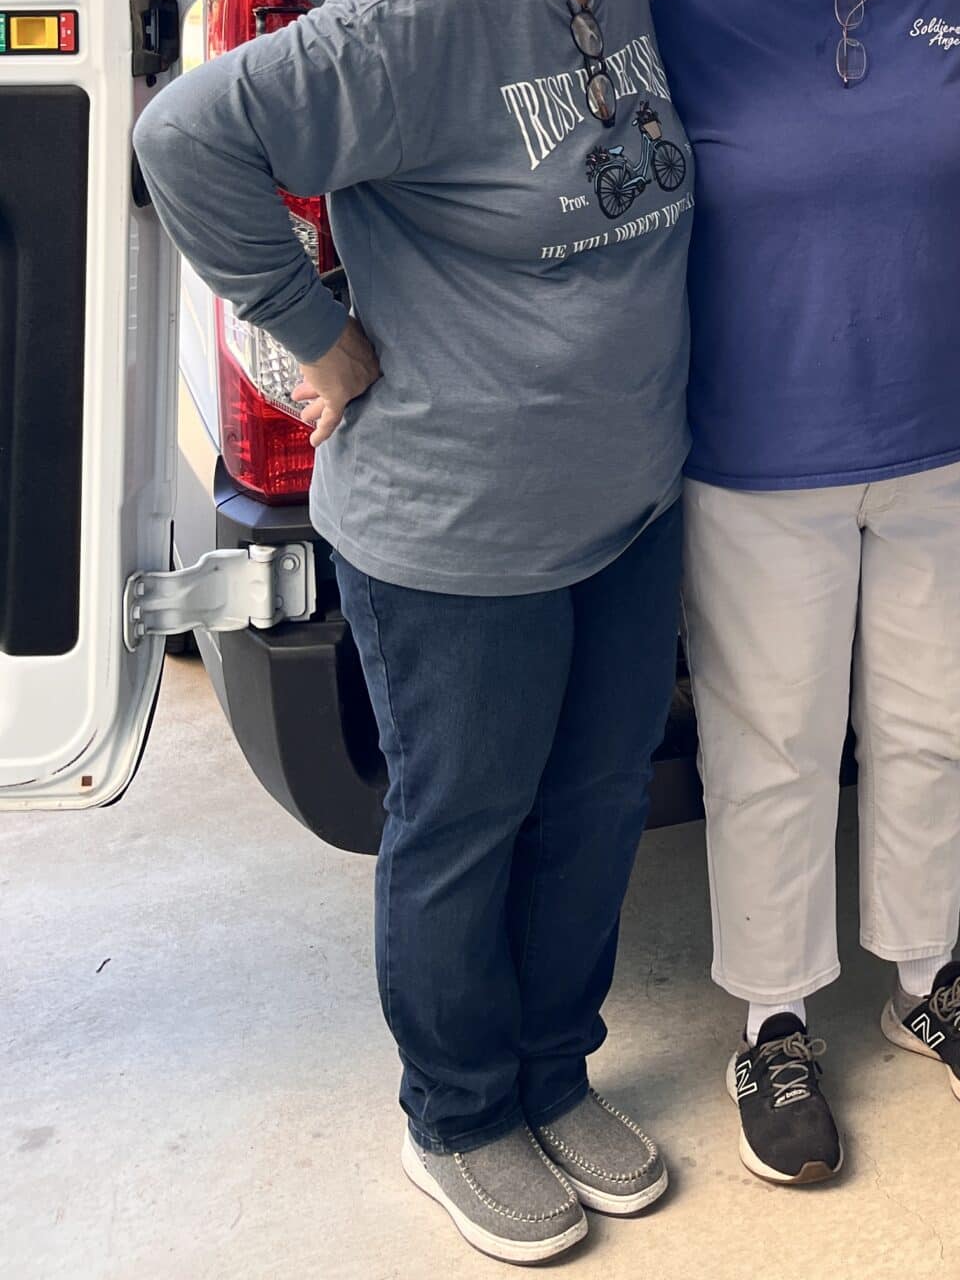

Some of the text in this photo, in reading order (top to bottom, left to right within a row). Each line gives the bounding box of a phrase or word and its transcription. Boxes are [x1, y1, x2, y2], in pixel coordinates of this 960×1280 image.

[500, 73, 585, 170] TRUST
[560, 195, 589, 213] Prov.
[541, 244, 568, 259] HE
[615, 211, 660, 243] DIRECT
